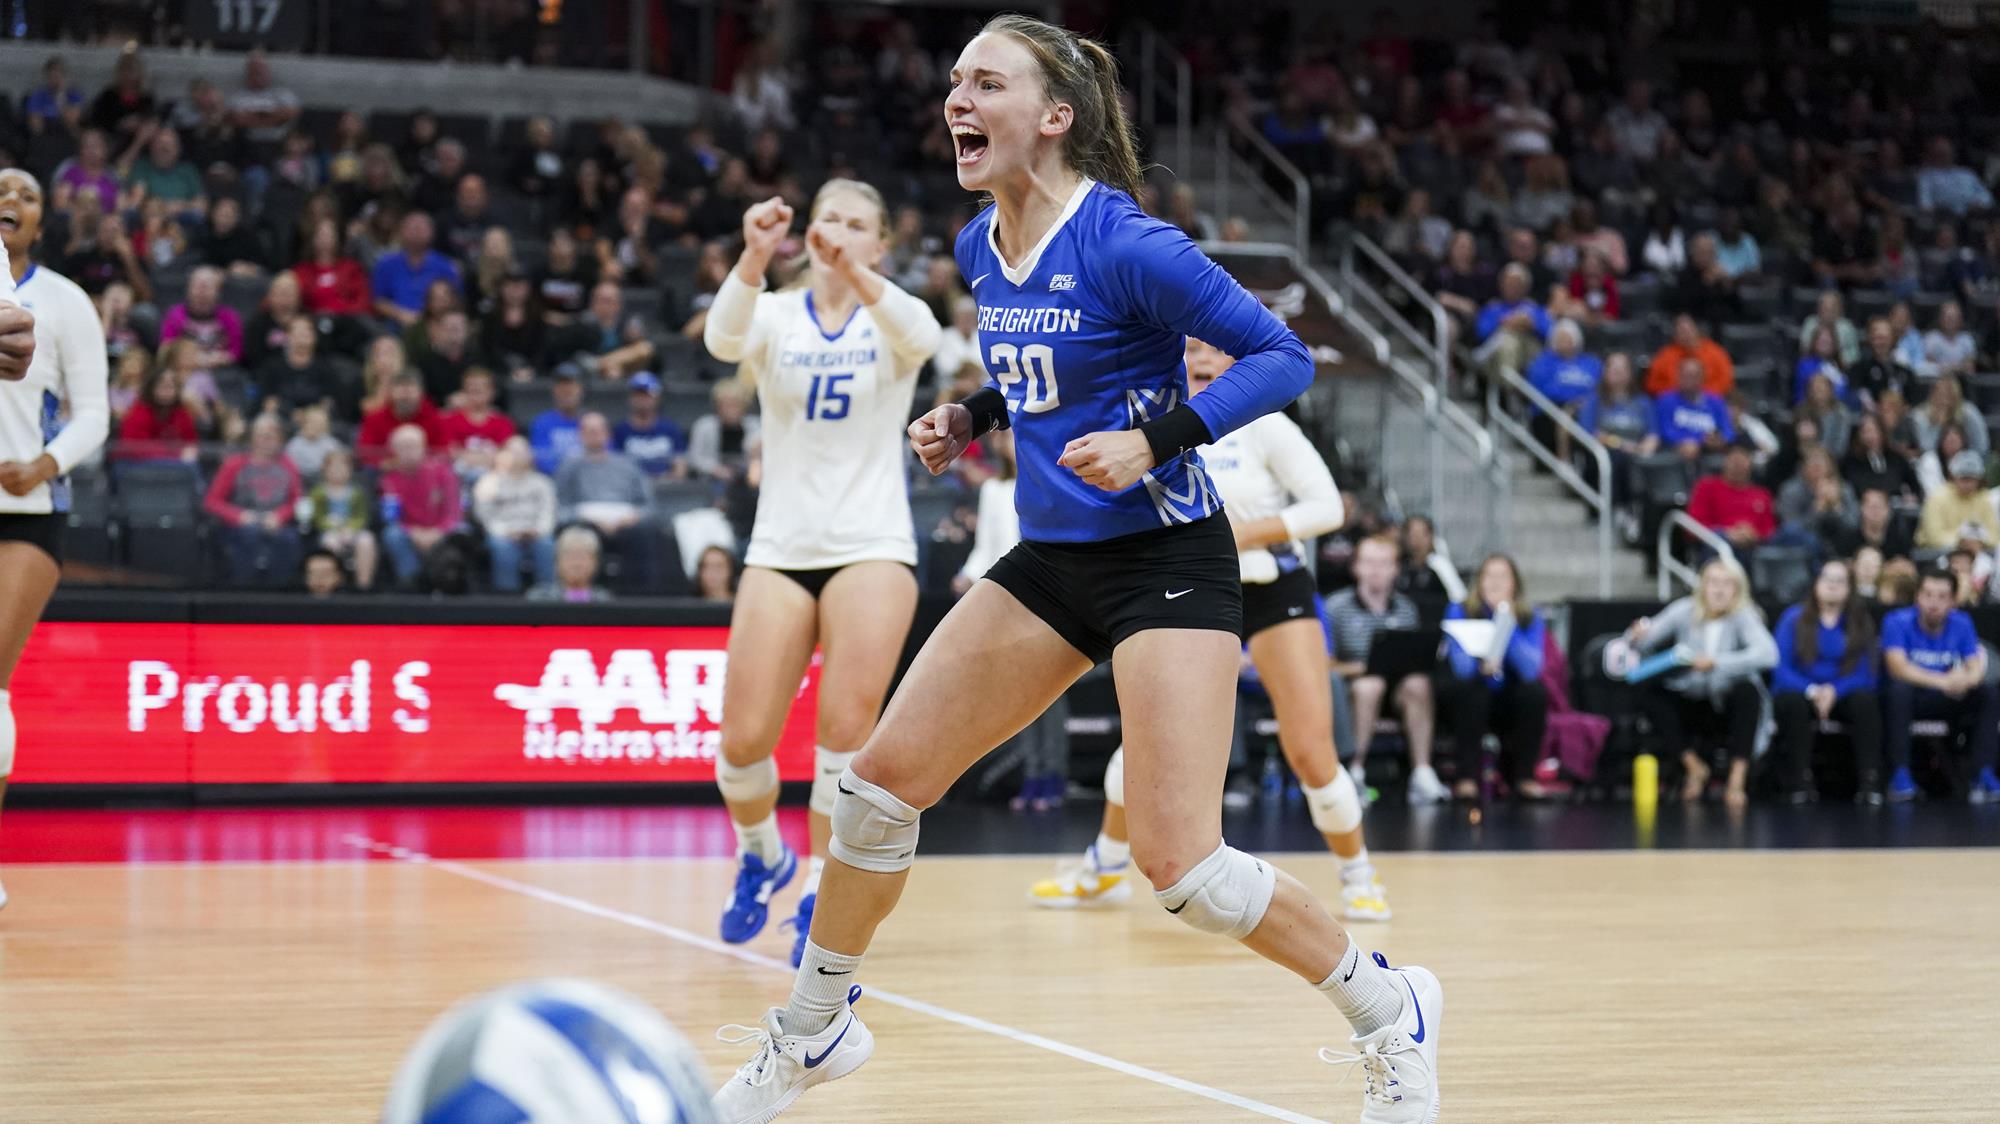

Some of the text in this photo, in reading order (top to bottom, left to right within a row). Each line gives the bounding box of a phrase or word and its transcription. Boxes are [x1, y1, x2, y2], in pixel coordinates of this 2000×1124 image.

[214, 0, 281, 33] 117
[1049, 281, 1077, 289] EAST
[1051, 274, 1073, 282] BIG
[977, 305, 1081, 333] CREIGHTON
[780, 349, 877, 367] CREIGHTON
[990, 343, 1060, 413] 20
[806, 373, 854, 421] 15
[128, 660, 371, 733] Proud
[494, 648, 728, 724] AAR
